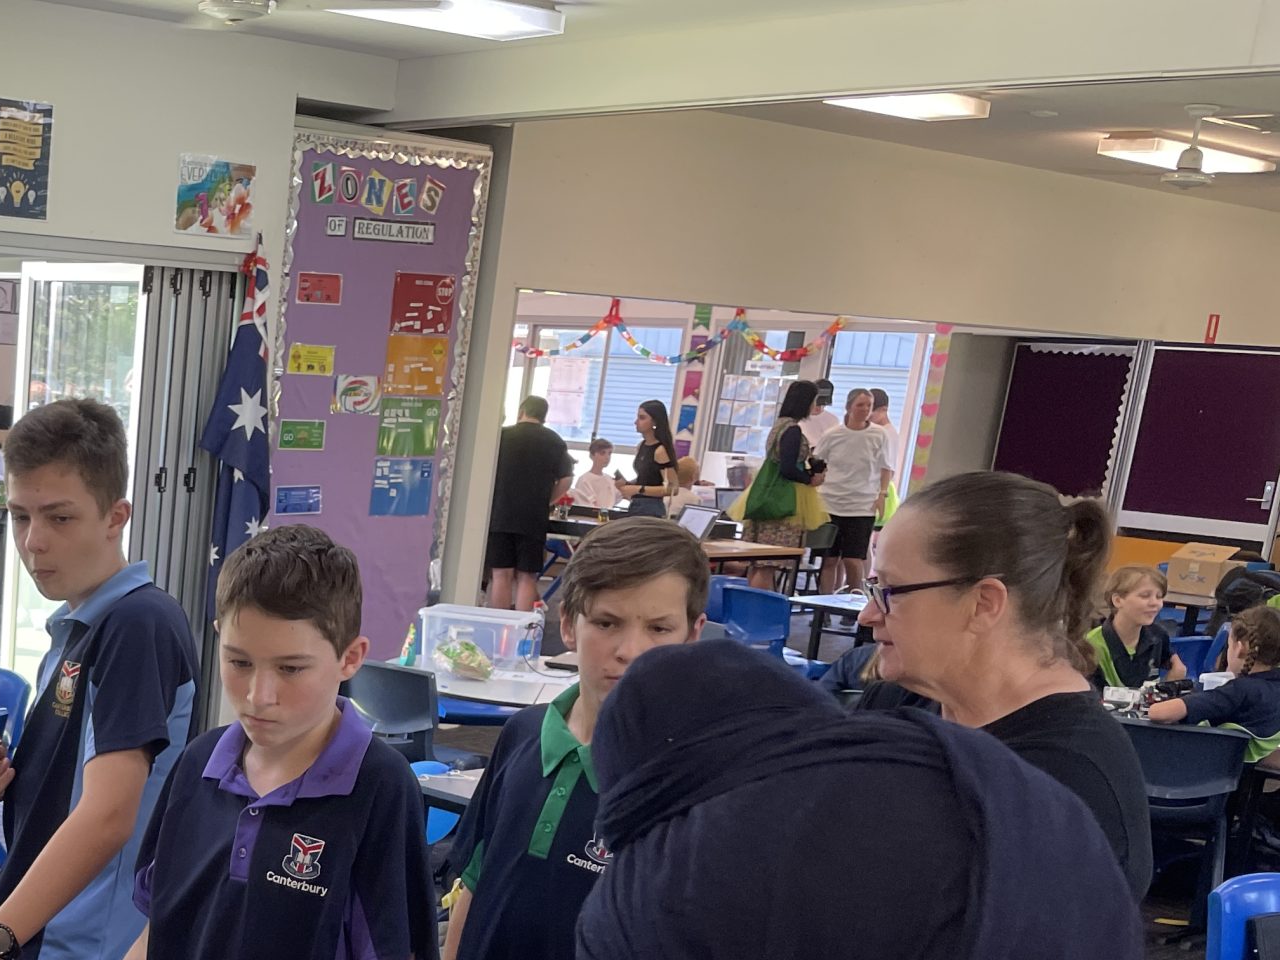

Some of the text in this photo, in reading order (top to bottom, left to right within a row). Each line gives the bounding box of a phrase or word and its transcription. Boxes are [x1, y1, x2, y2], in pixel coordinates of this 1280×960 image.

[312, 165, 441, 214] ZONES
[329, 218, 431, 241] OF REGULATION
[266, 871, 328, 896] Canterbury
